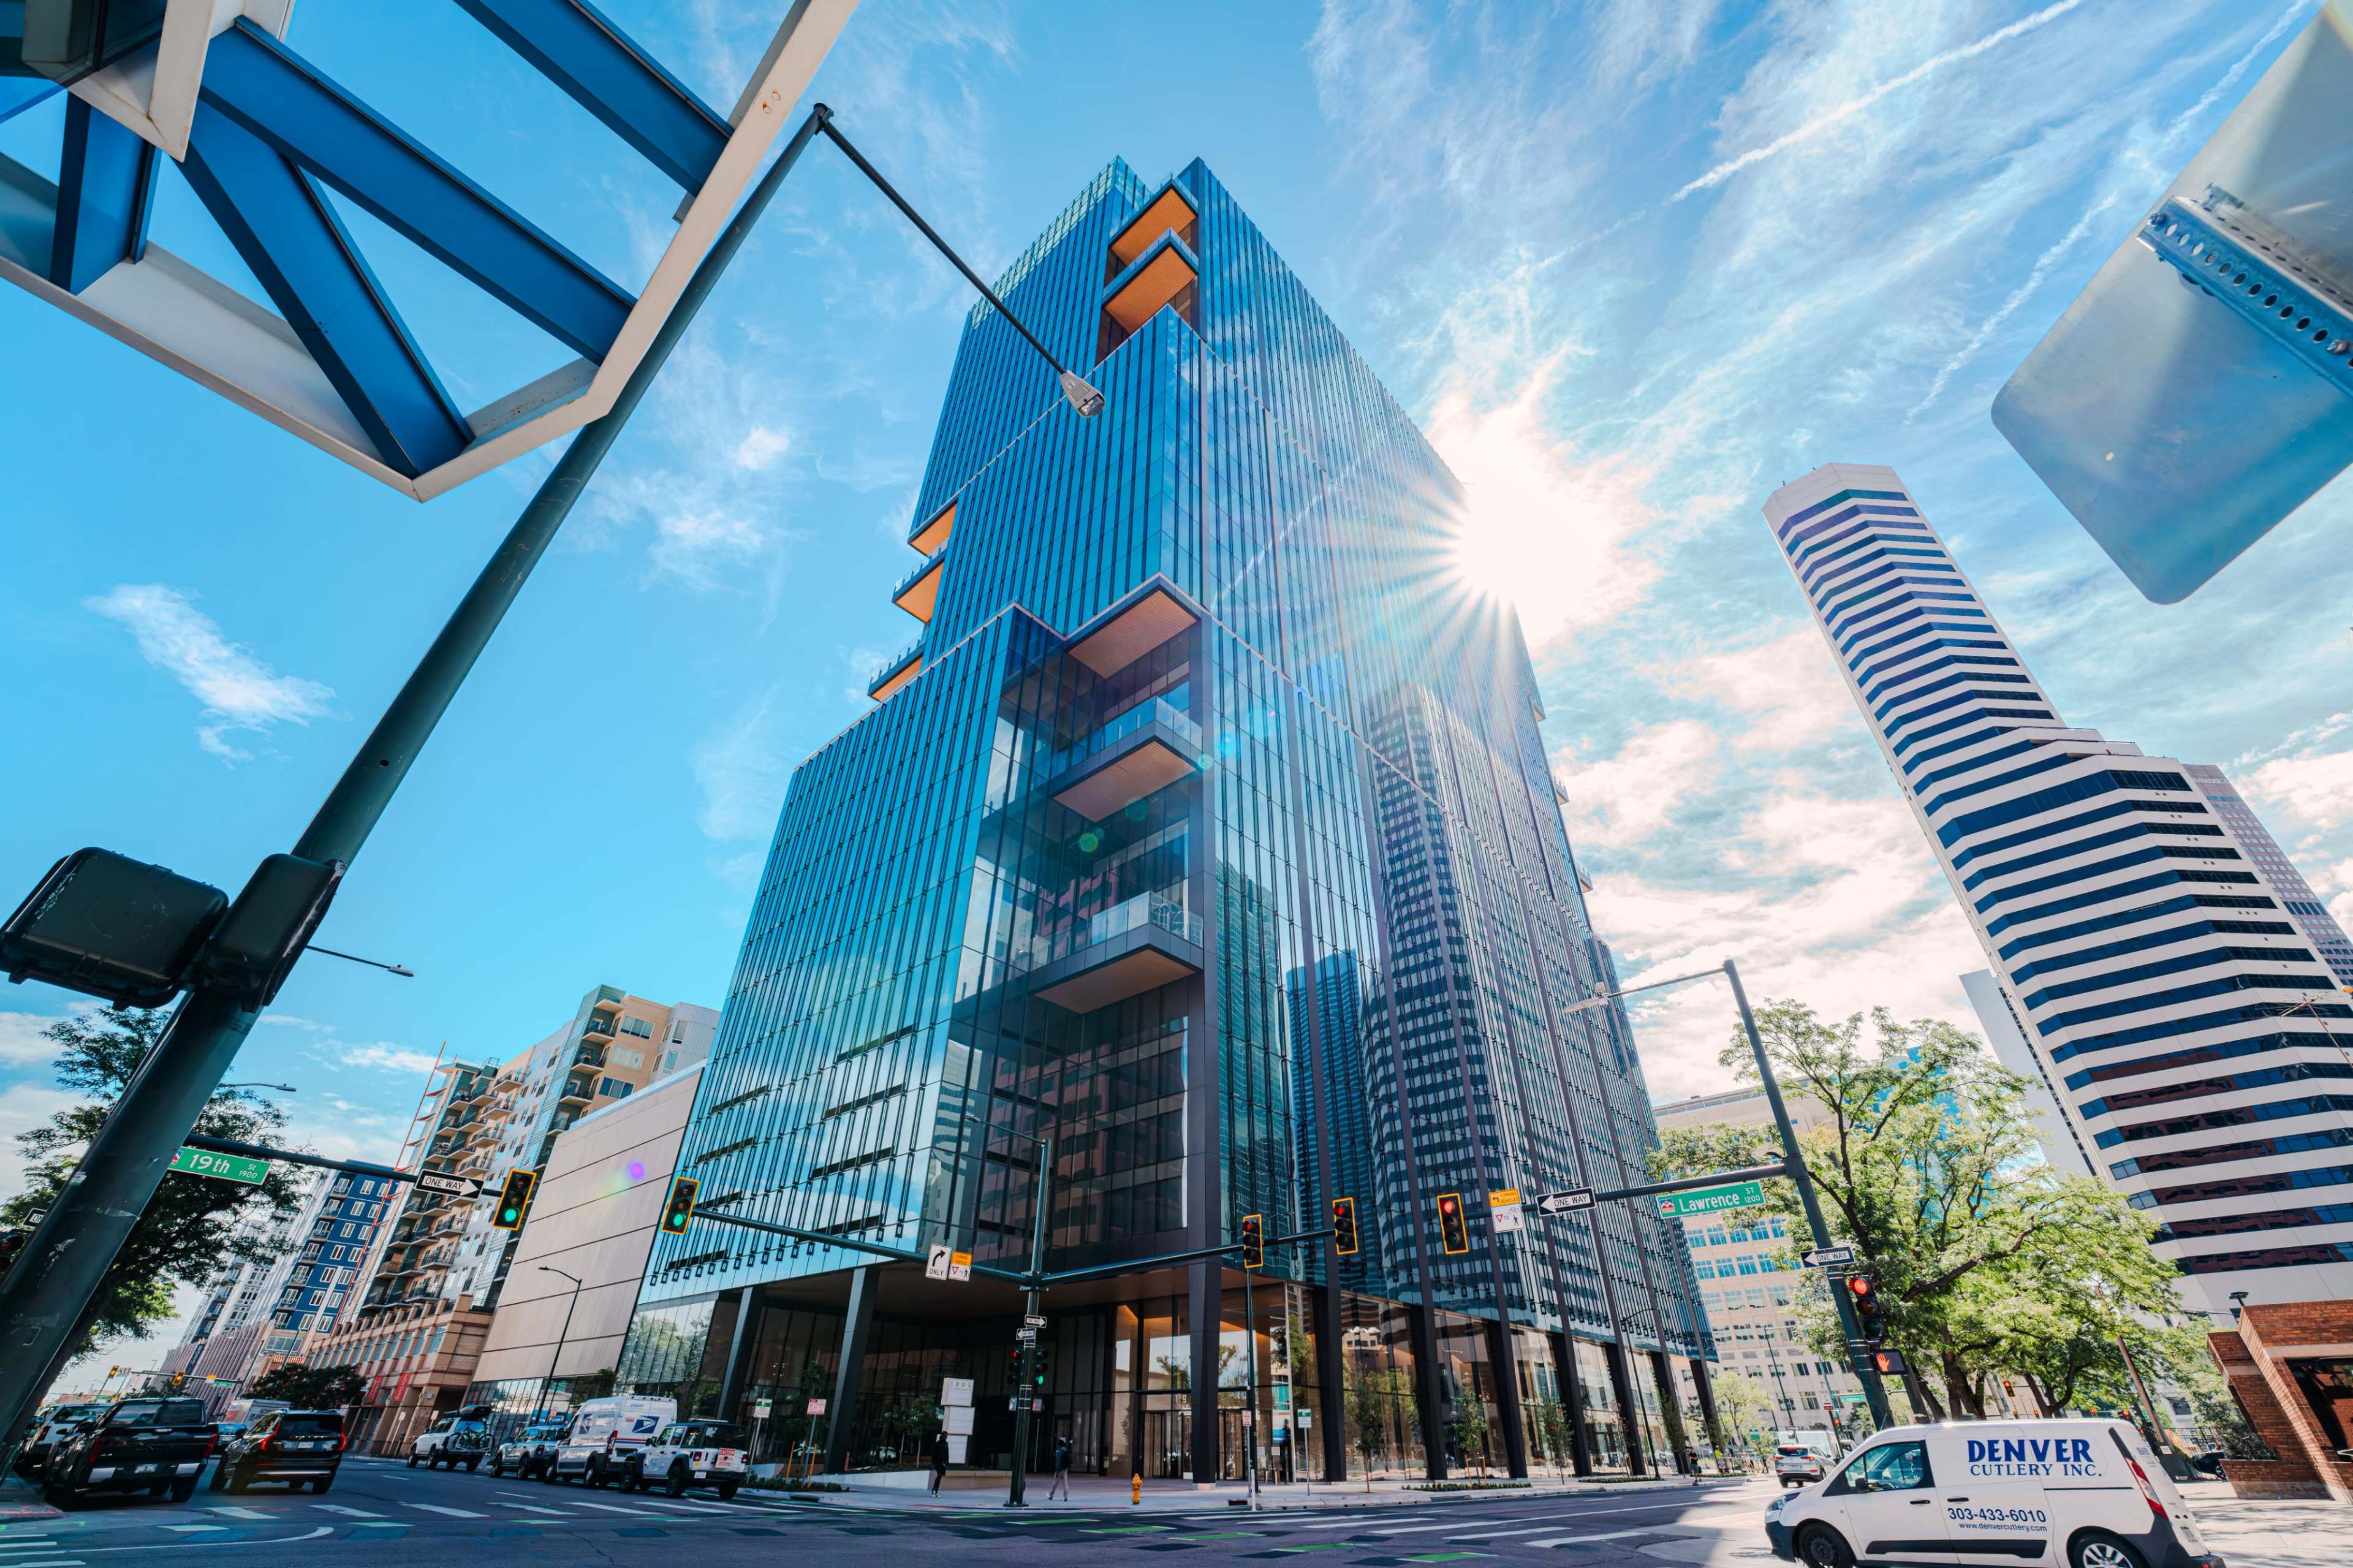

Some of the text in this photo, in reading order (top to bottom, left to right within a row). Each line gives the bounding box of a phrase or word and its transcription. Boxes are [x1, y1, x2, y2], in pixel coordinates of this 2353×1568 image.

[189, 1154, 230, 1174] 19th
[238, 1170, 257, 1179] 1900
[425, 1177, 464, 1190] ONE WAY
[1554, 1195, 1587, 1207] ONE WAY
[1679, 1194, 1740, 1212] Lawrence
[929, 1268, 944, 1276] ONLY
[1967, 1439, 2094, 1463] DENVER
[1970, 1464, 2102, 1477] CUTLERY INC.
[1947, 1507, 2046, 1523] 303-433-6010
[1958, 1522, 2047, 1532] www.denvercutlery.com
